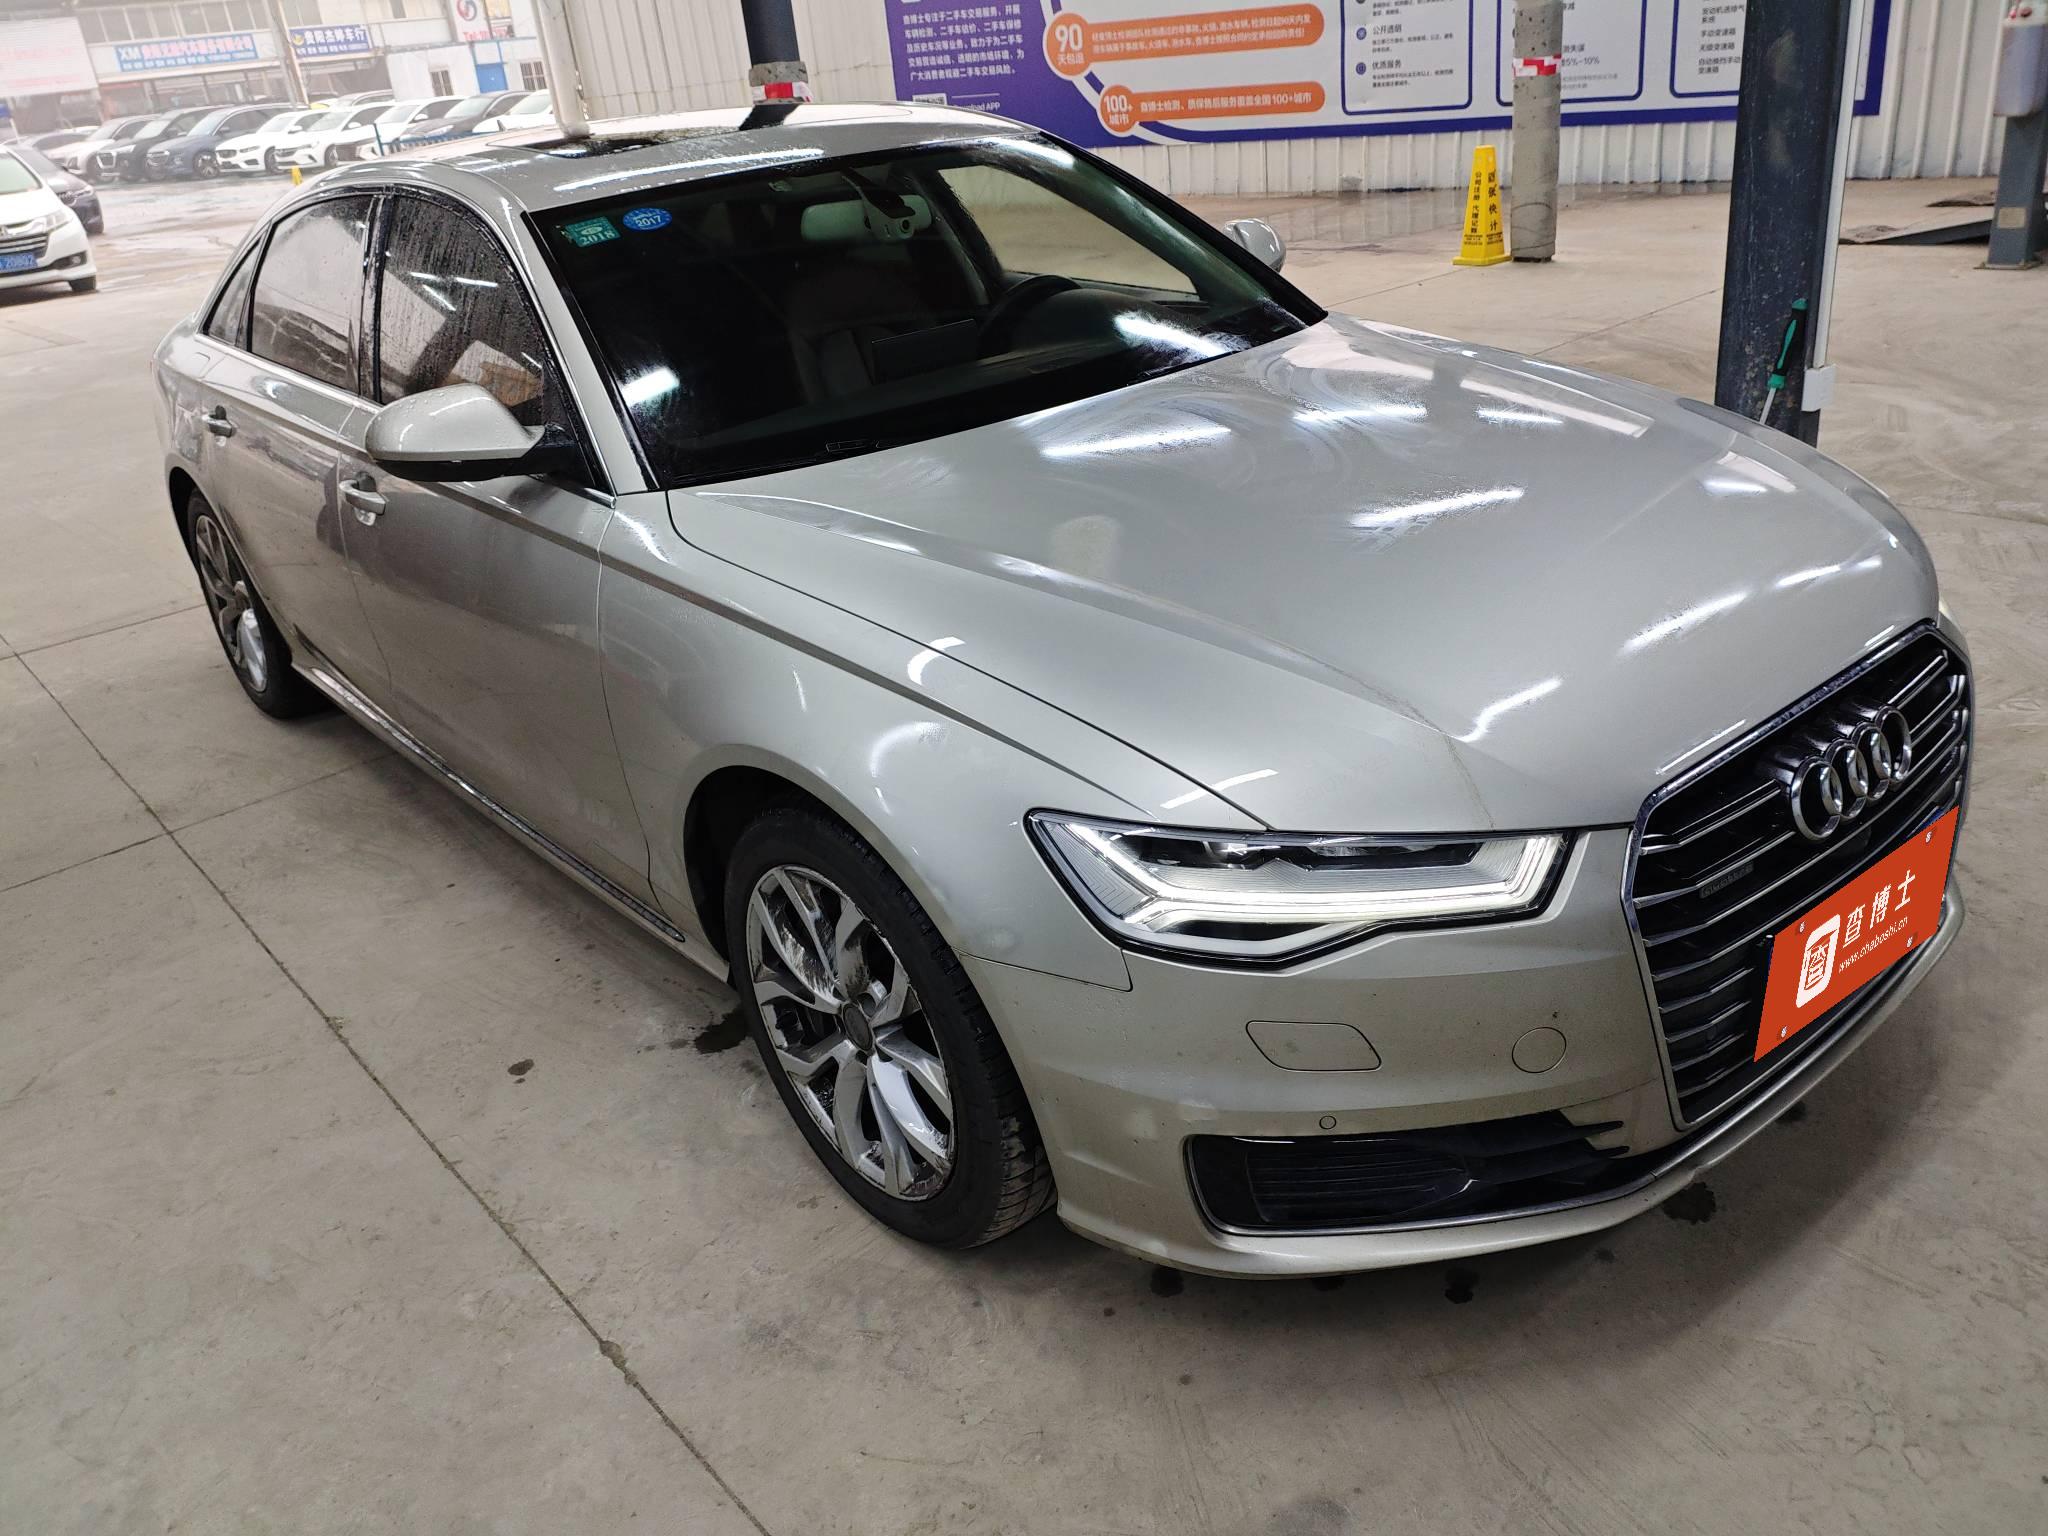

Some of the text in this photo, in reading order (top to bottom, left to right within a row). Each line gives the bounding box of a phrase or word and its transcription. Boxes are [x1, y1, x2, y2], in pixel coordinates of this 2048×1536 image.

[1055, 23, 1084, 53] 90
[1103, 94, 1134, 113] 100+
[1109, 113, 1130, 125] 城市
[635, 215, 662, 228] 2017
[579, 231, 615, 245] 2018
